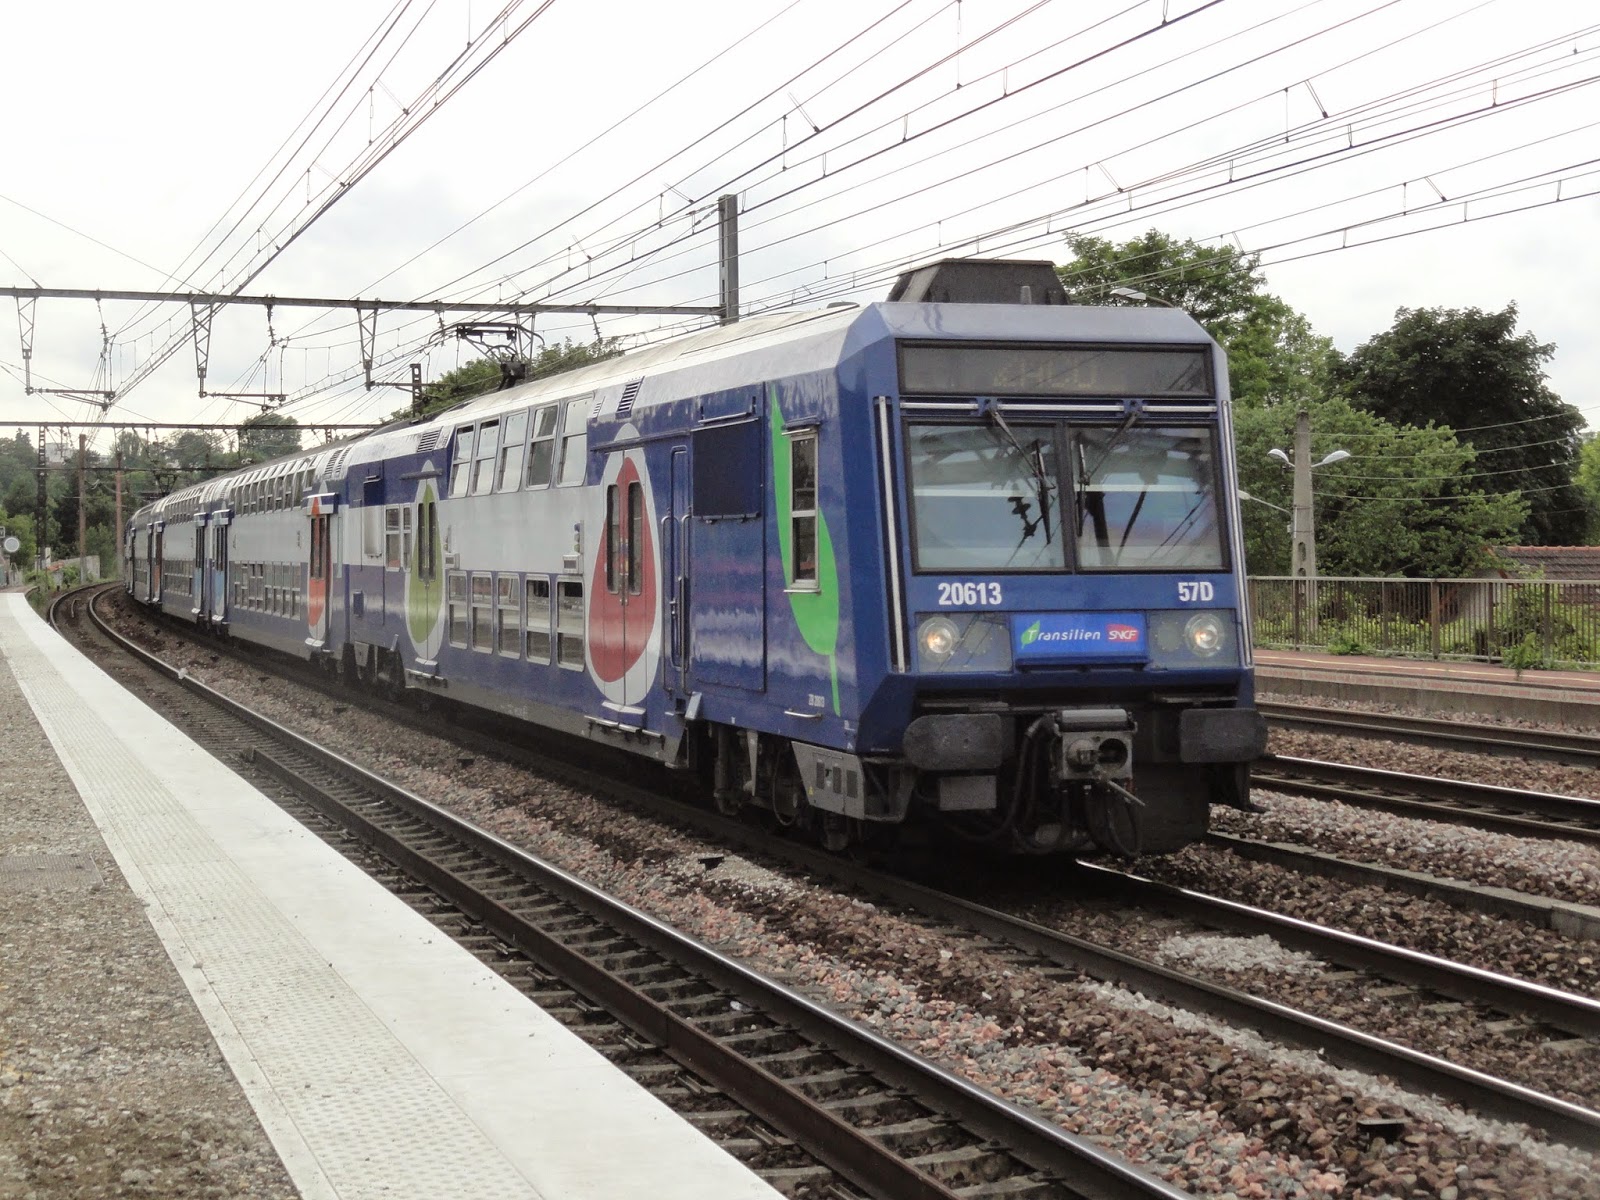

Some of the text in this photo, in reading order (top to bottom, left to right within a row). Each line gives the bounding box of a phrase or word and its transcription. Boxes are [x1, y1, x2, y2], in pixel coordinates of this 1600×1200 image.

[937, 582, 1002, 606] 20613
[1178, 581, 1214, 602] 57D
[1027, 628, 1101, 641] Transilien
[1107, 629, 1138, 641] SNCF
